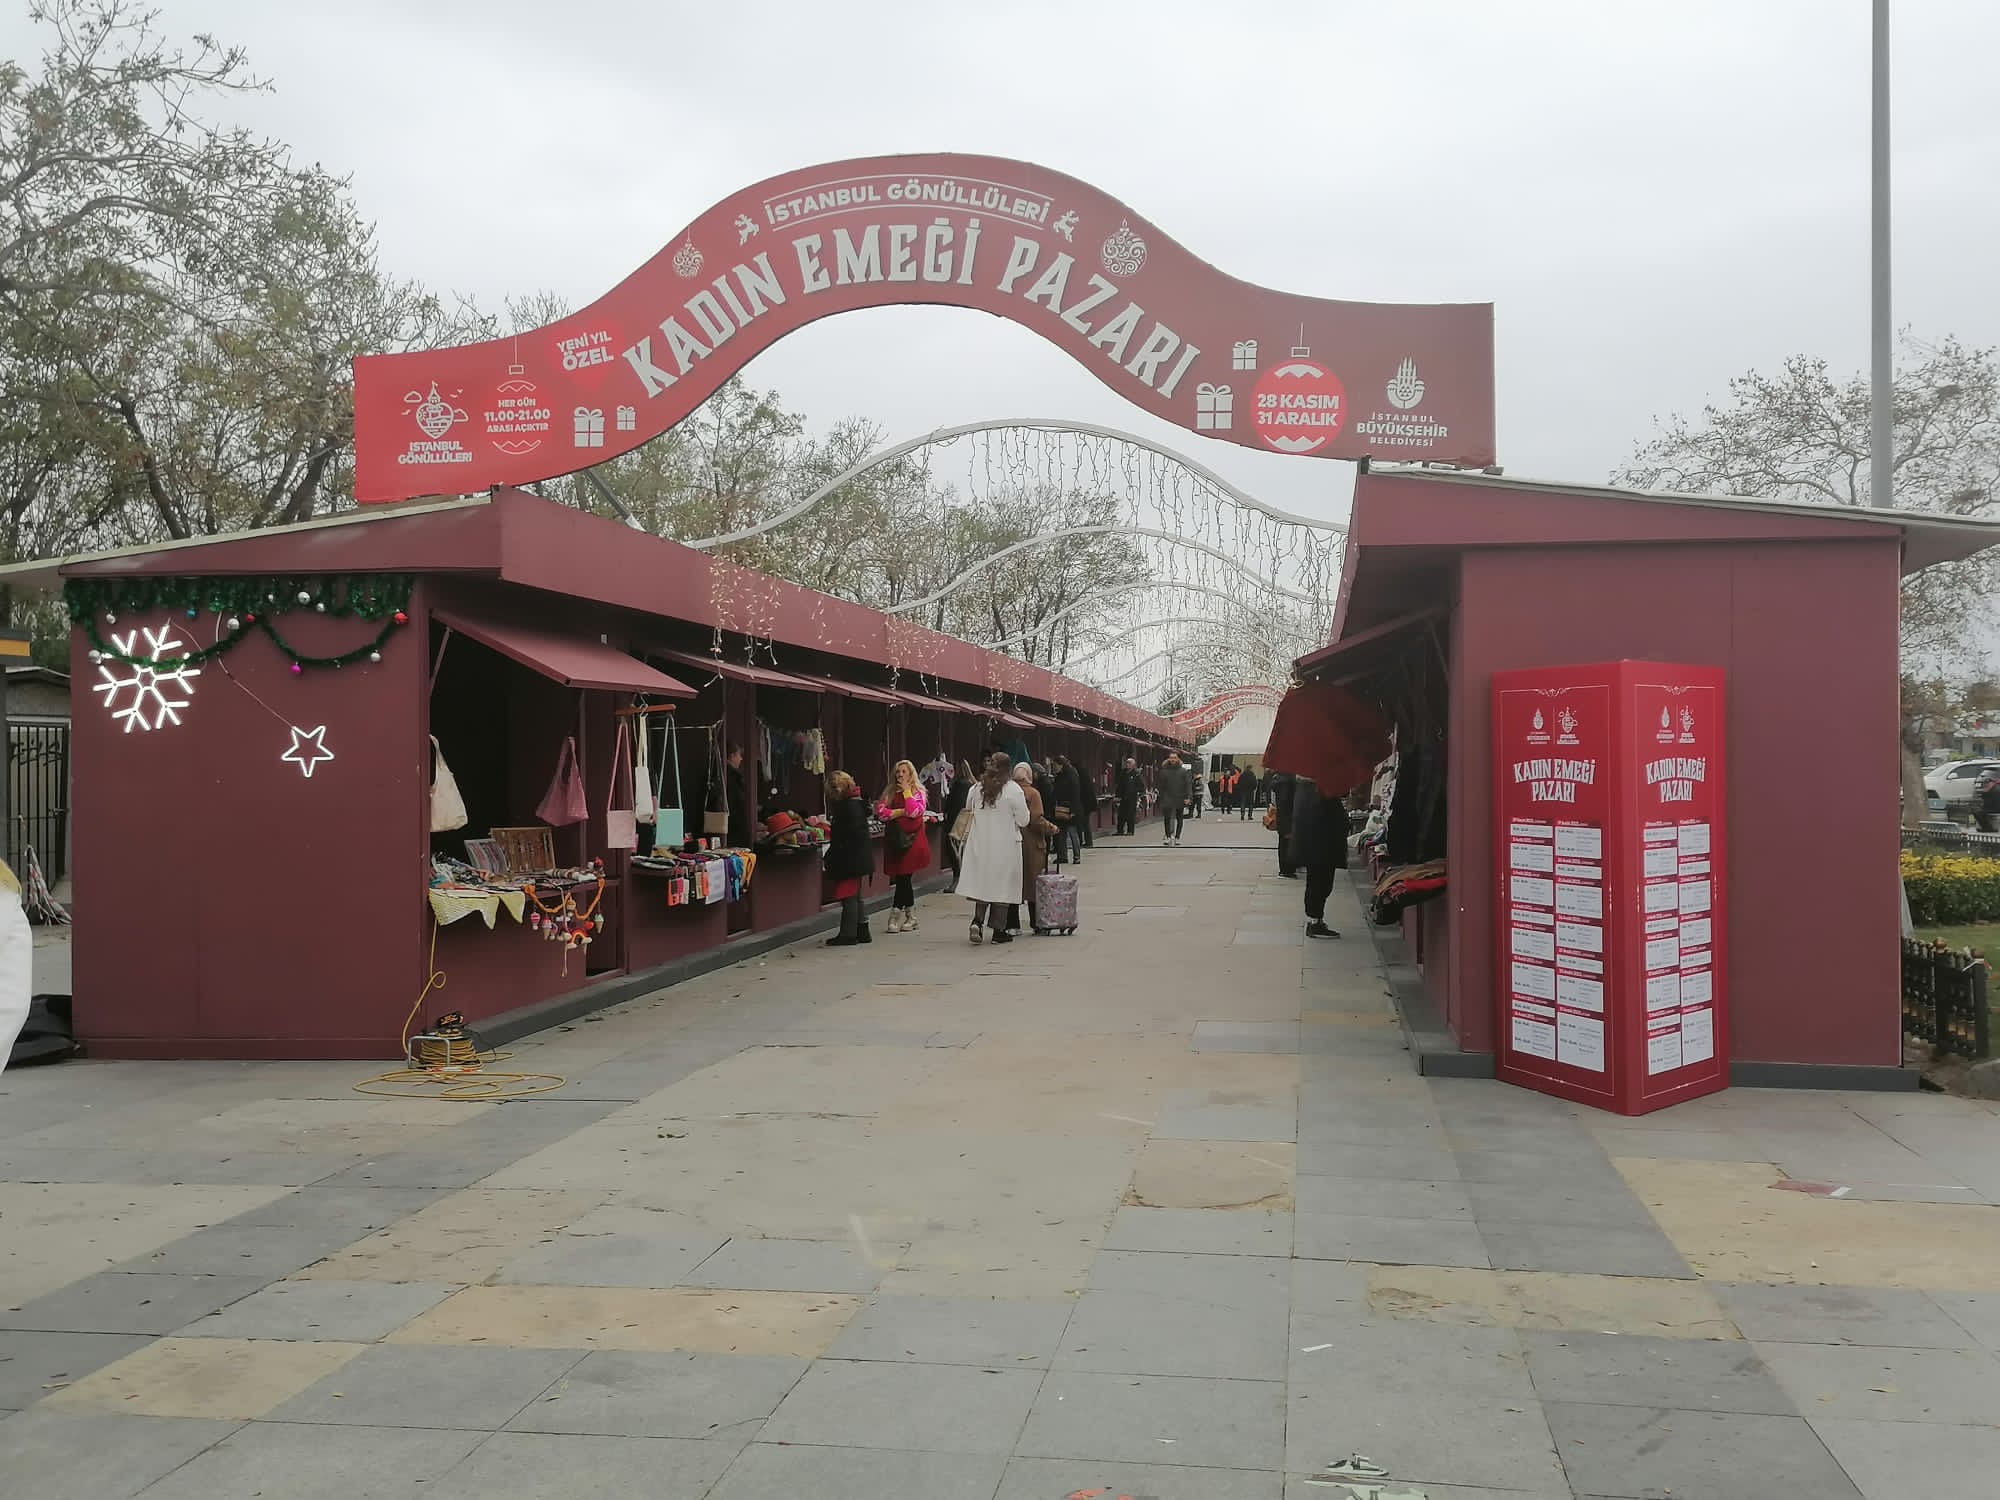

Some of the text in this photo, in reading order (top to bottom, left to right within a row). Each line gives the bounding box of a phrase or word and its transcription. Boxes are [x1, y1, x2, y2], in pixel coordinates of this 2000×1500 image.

[765, 179, 1049, 224] İSTANBUL GÖNÜLLÜLERİ
[622, 218, 1200, 399] KADIN EMEĞİ PAZARI
[556, 330, 612, 352] YENİ YIL
[563, 346, 614, 371] ÖZEL
[498, 397, 536, 407] HER GÜN
[1257, 393, 1339, 409] 28 KASIM
[484, 408, 550, 422] 11.00-21.00
[1257, 410, 1338, 426] 31 ARALIK
[1371, 411, 1436, 423] İSTANBUL
[487, 424, 513, 433] ARASI
[1357, 421, 1448, 437] BÜYÜKŞEHİR
[1370, 436, 1433, 447] BELEDİYESİ
[1513, 758, 1552, 784] KADIN
[1646, 757, 1676, 785] KADIN
[1531, 781, 1576, 803] PAZARI
[1660, 780, 1693, 804] PAZARI
